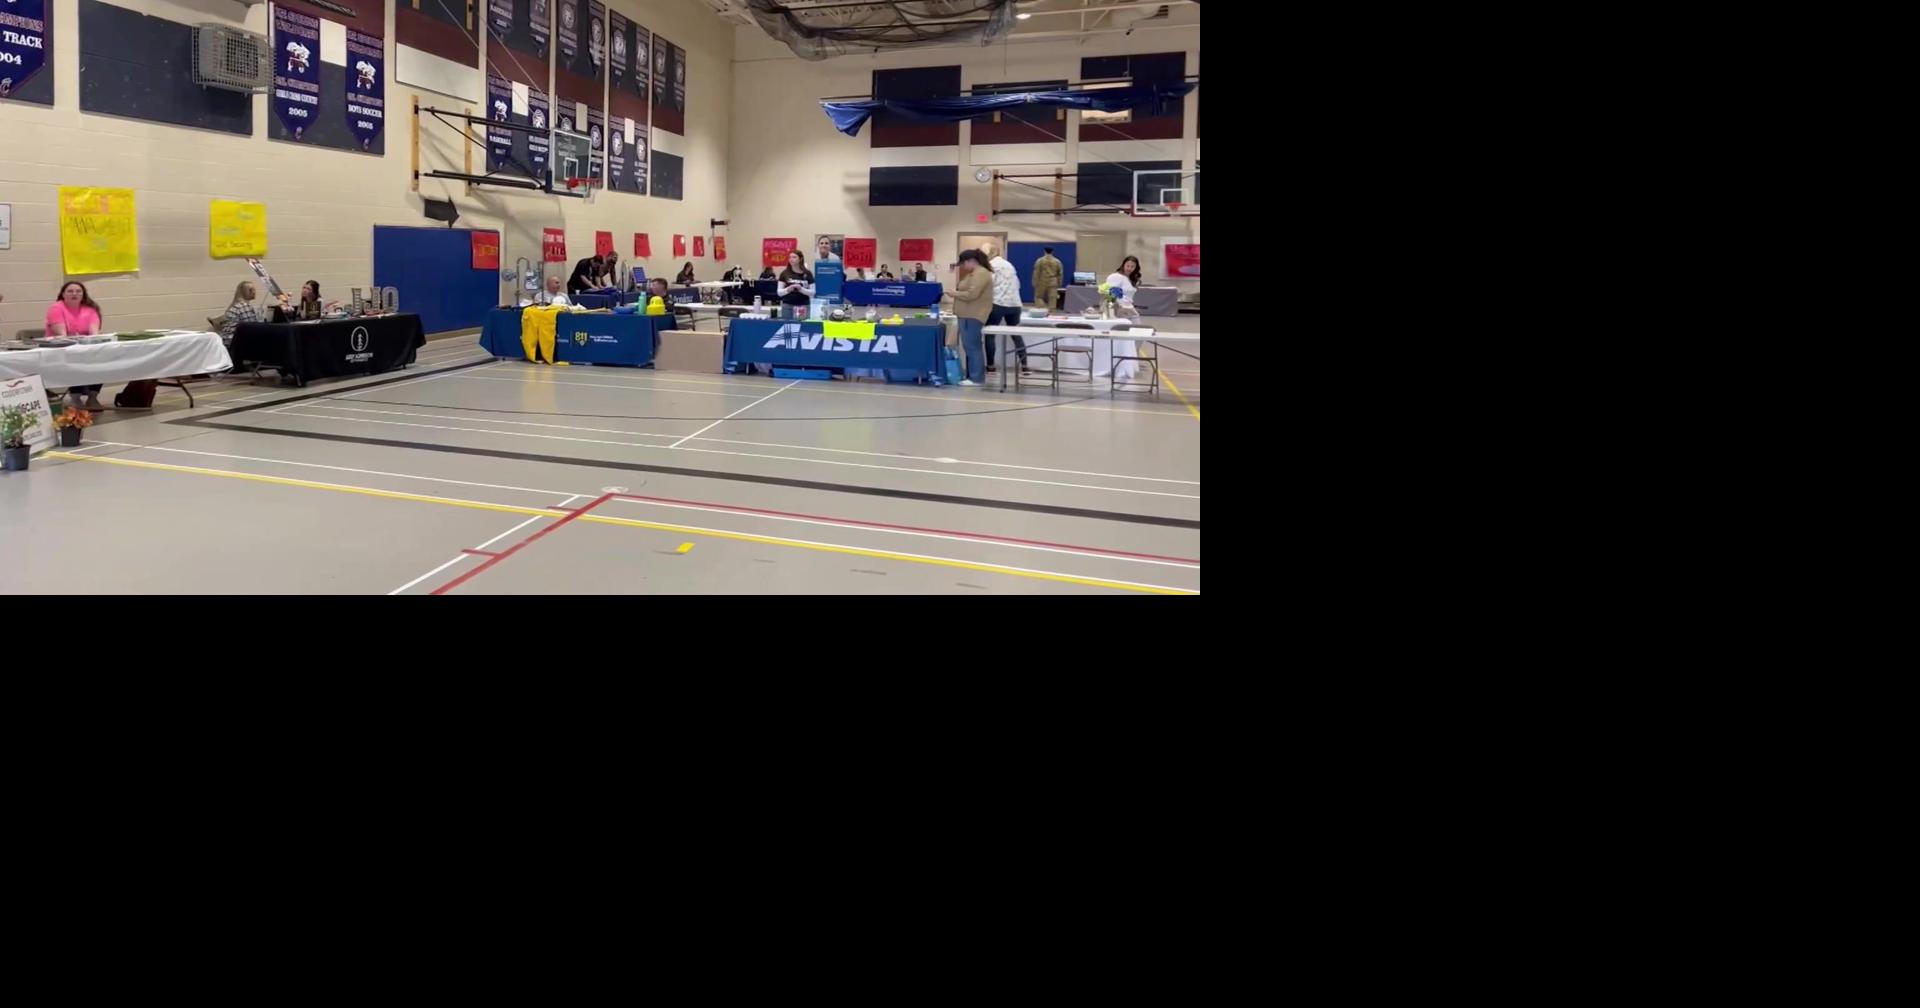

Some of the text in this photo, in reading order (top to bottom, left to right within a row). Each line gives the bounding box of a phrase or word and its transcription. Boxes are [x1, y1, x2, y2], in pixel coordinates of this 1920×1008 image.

[3, 30, 43, 48] TRACK
[362, 107, 382, 118] SOCCER
[575, 331, 588, 341] 811
[763, 323, 899, 354] AVISTA
